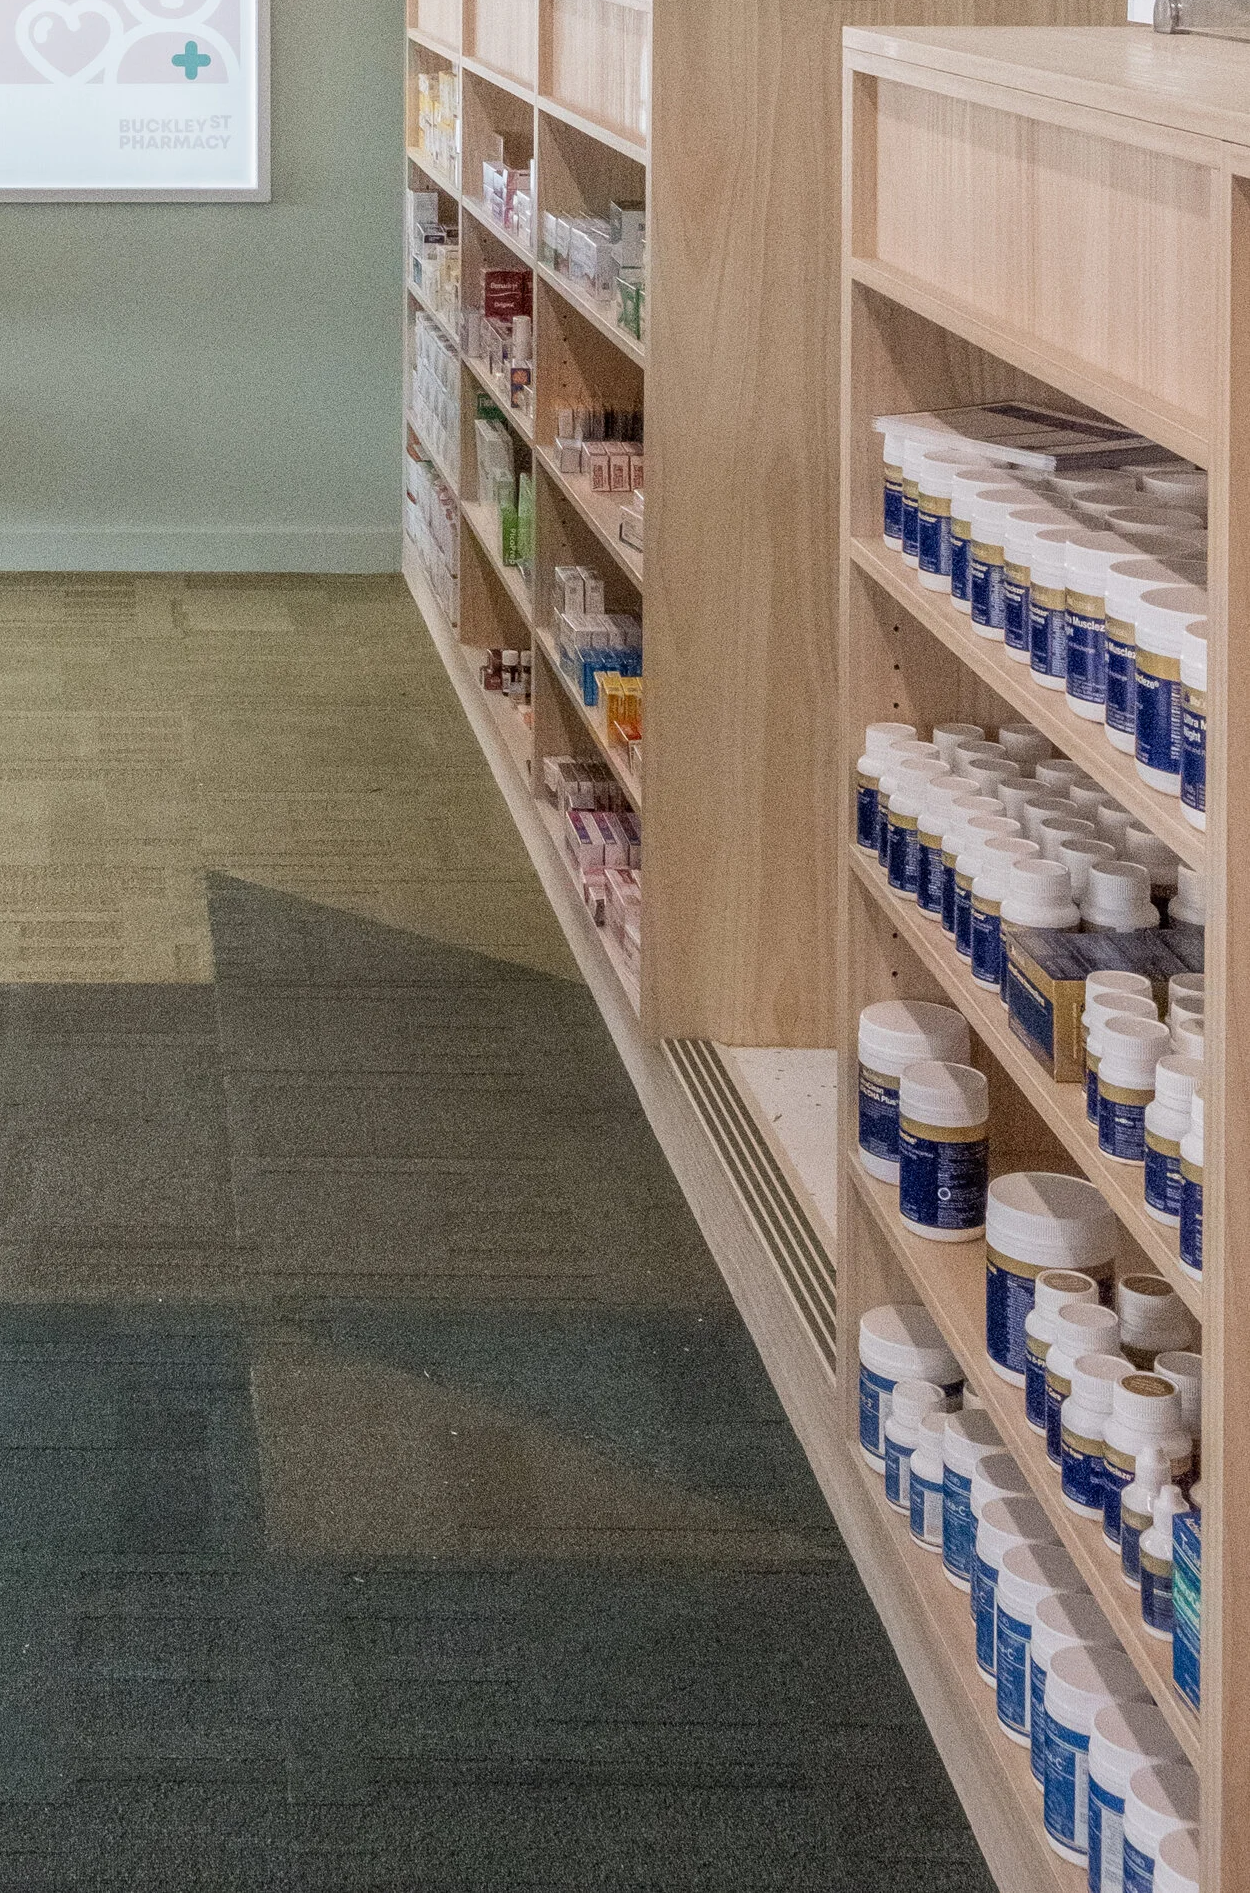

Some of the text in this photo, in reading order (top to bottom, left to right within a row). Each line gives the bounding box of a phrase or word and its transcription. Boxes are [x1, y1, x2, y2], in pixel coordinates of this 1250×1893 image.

[120, 114, 232, 133] BUCKLEY ST
[119, 134, 231, 150] PHARMACY
